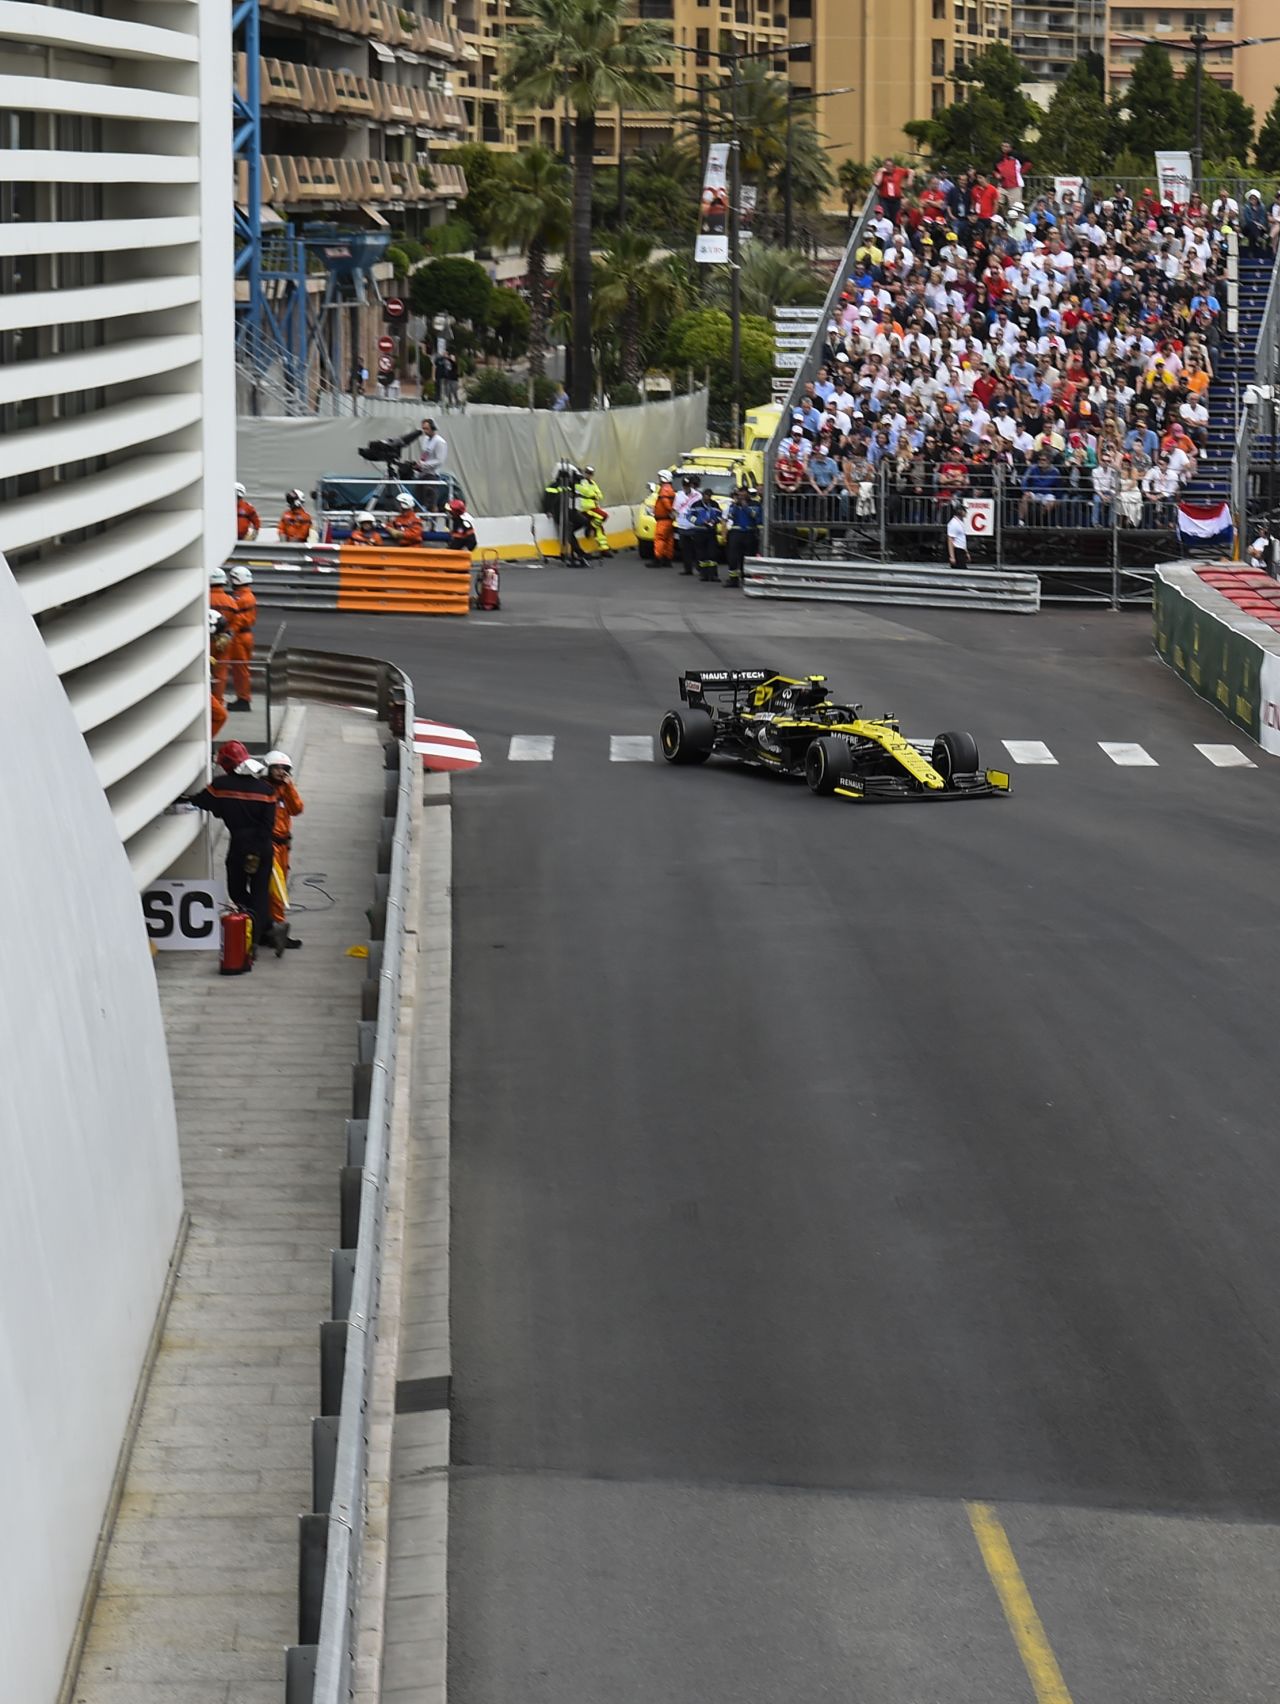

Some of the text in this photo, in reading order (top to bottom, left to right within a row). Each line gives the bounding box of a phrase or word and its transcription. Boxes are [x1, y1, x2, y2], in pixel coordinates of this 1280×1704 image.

[971, 512, 987, 532] C
[700, 672, 727, 680] NAULT
[754, 685, 773, 706] 27
[840, 777, 864, 790] RENAULT
[142, 890, 214, 939] SC
